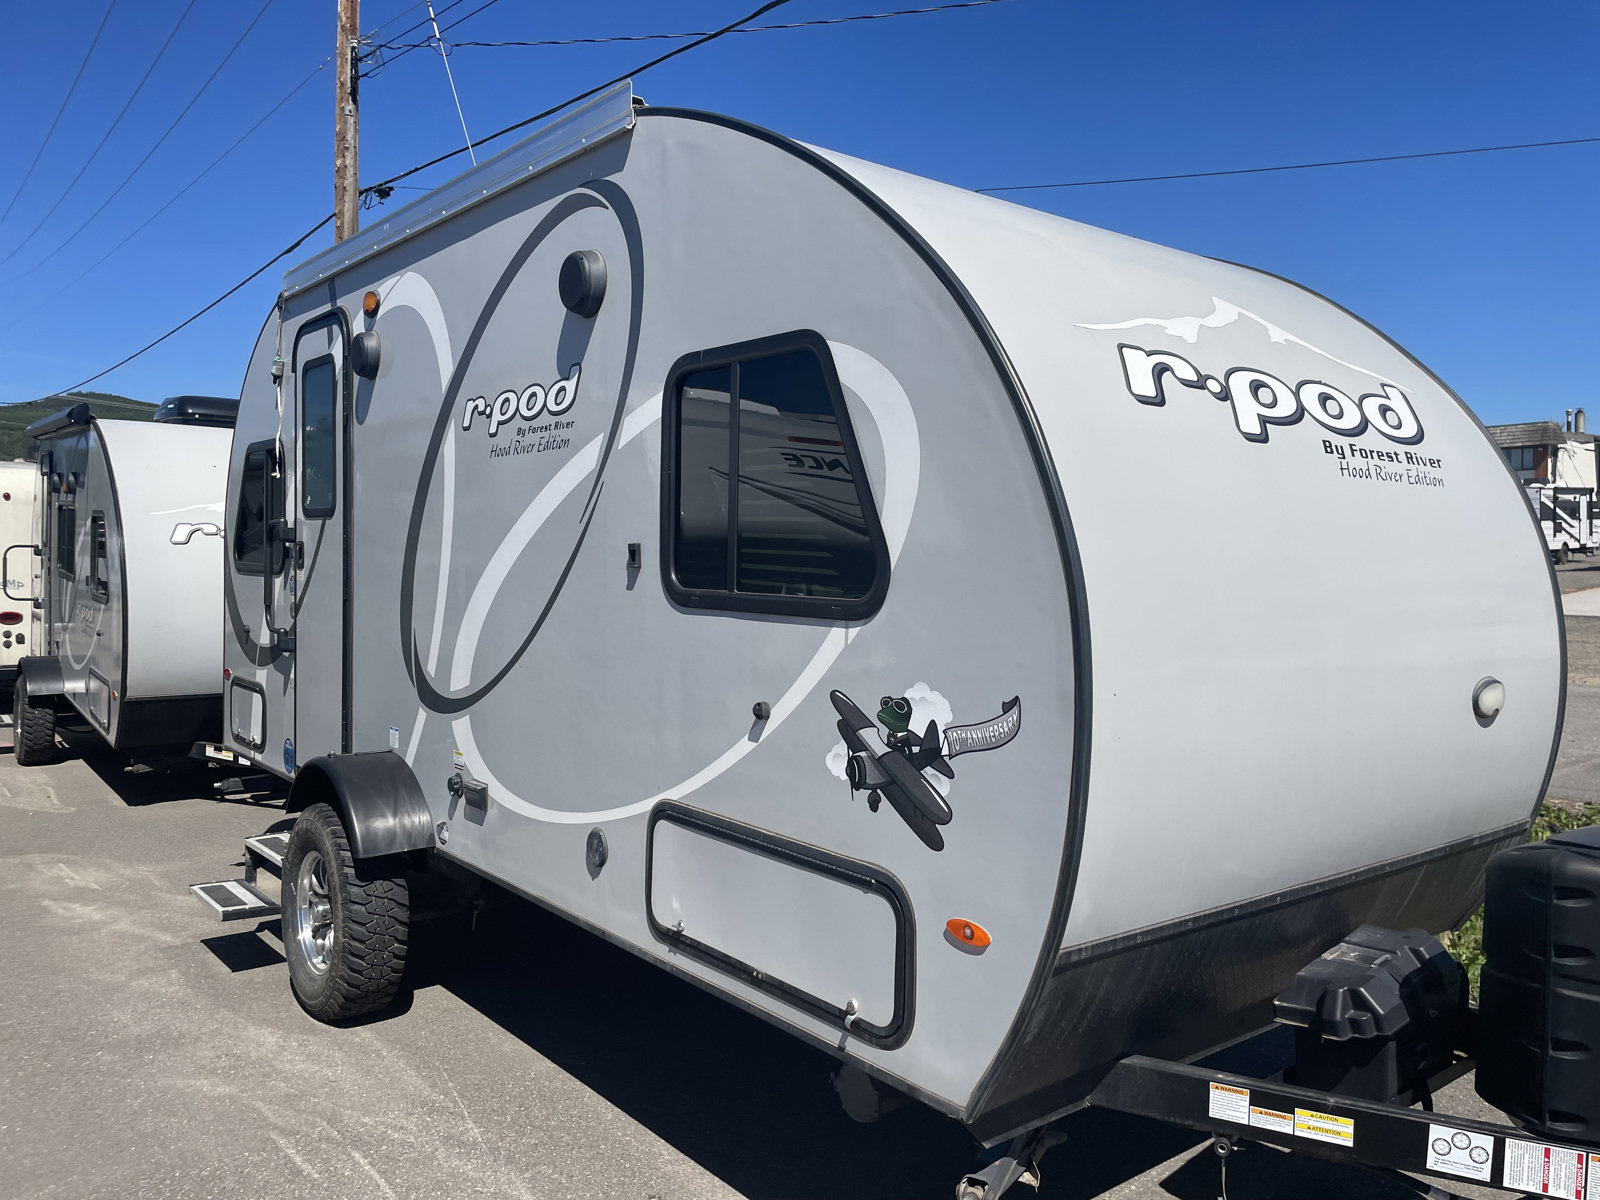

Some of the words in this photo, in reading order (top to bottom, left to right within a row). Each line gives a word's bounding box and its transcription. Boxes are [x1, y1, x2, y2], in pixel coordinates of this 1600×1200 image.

[516, 427, 526, 437] By
[527, 424, 552, 435] Forest
[553, 421, 575, 431] River
[489, 438, 513, 458] Hood
[513, 441, 535, 456] River
[537, 433, 570, 453] Edition
[1321, 439, 1346, 460] By
[1348, 443, 1402, 464] Forest
[1404, 451, 1442, 469] River
[1340, 460, 1373, 480] Hood
[1373, 464, 1403, 483] River
[1406, 467, 1445, 488] Edition
[967, 710, 1018, 747] ANNIVERSARY
[1219, 1085, 1244, 1095] WARNING
[1264, 1110, 1287, 1120] WARNING
[1315, 1113, 1339, 1123] CAUTION
[1312, 1126, 1341, 1136] ATTENTION
